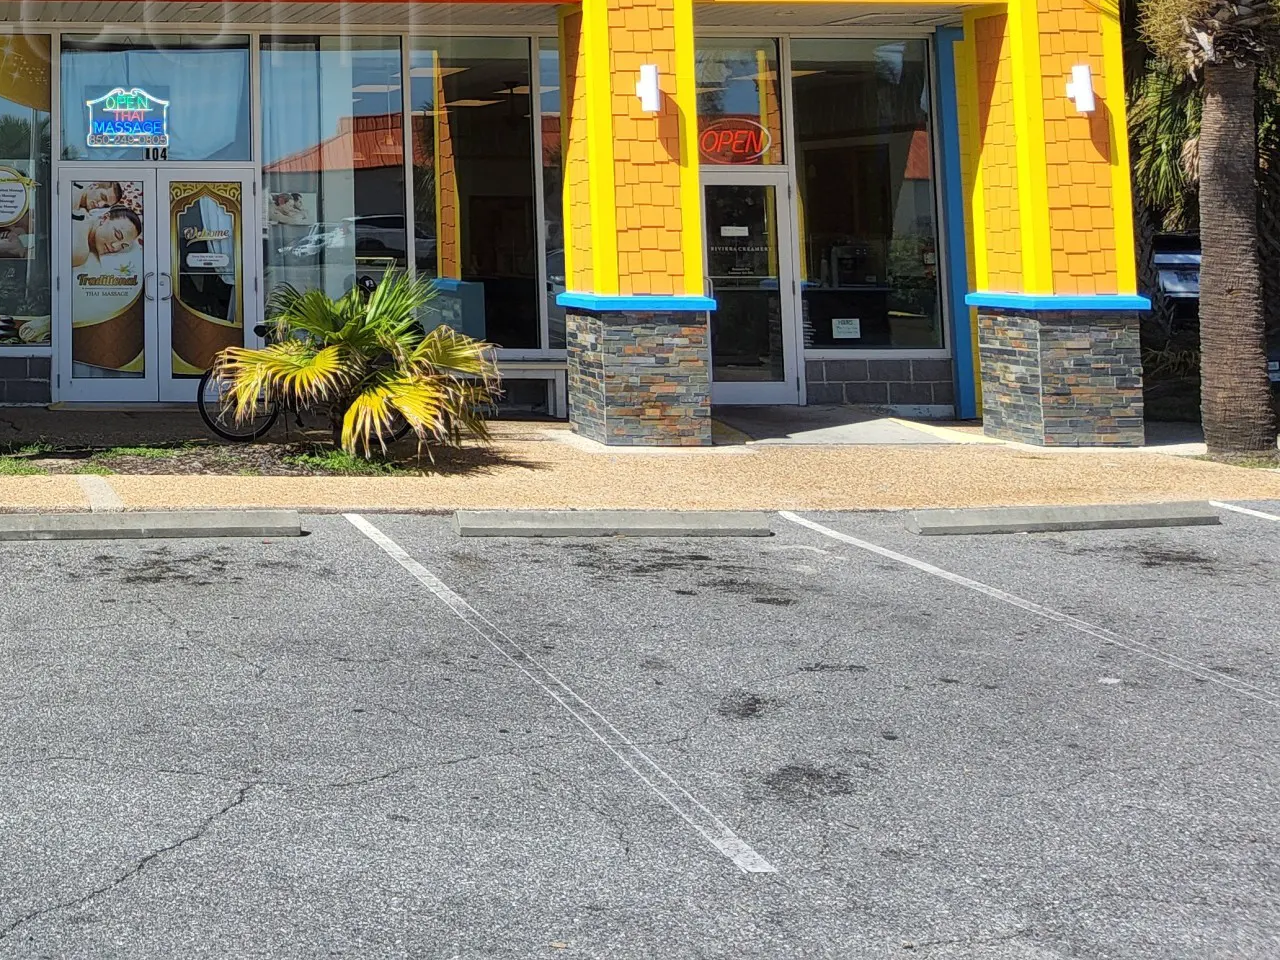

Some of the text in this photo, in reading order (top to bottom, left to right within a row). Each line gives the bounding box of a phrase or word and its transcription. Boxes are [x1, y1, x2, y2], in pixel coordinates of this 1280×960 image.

[105, 96, 148, 109] OPEN
[113, 110, 145, 121] THAI
[94, 121, 162, 134] MASSAGE
[700, 130, 764, 153] OPEN
[145, 147, 167, 160] 104
[77, 273, 138, 286] Traditional
